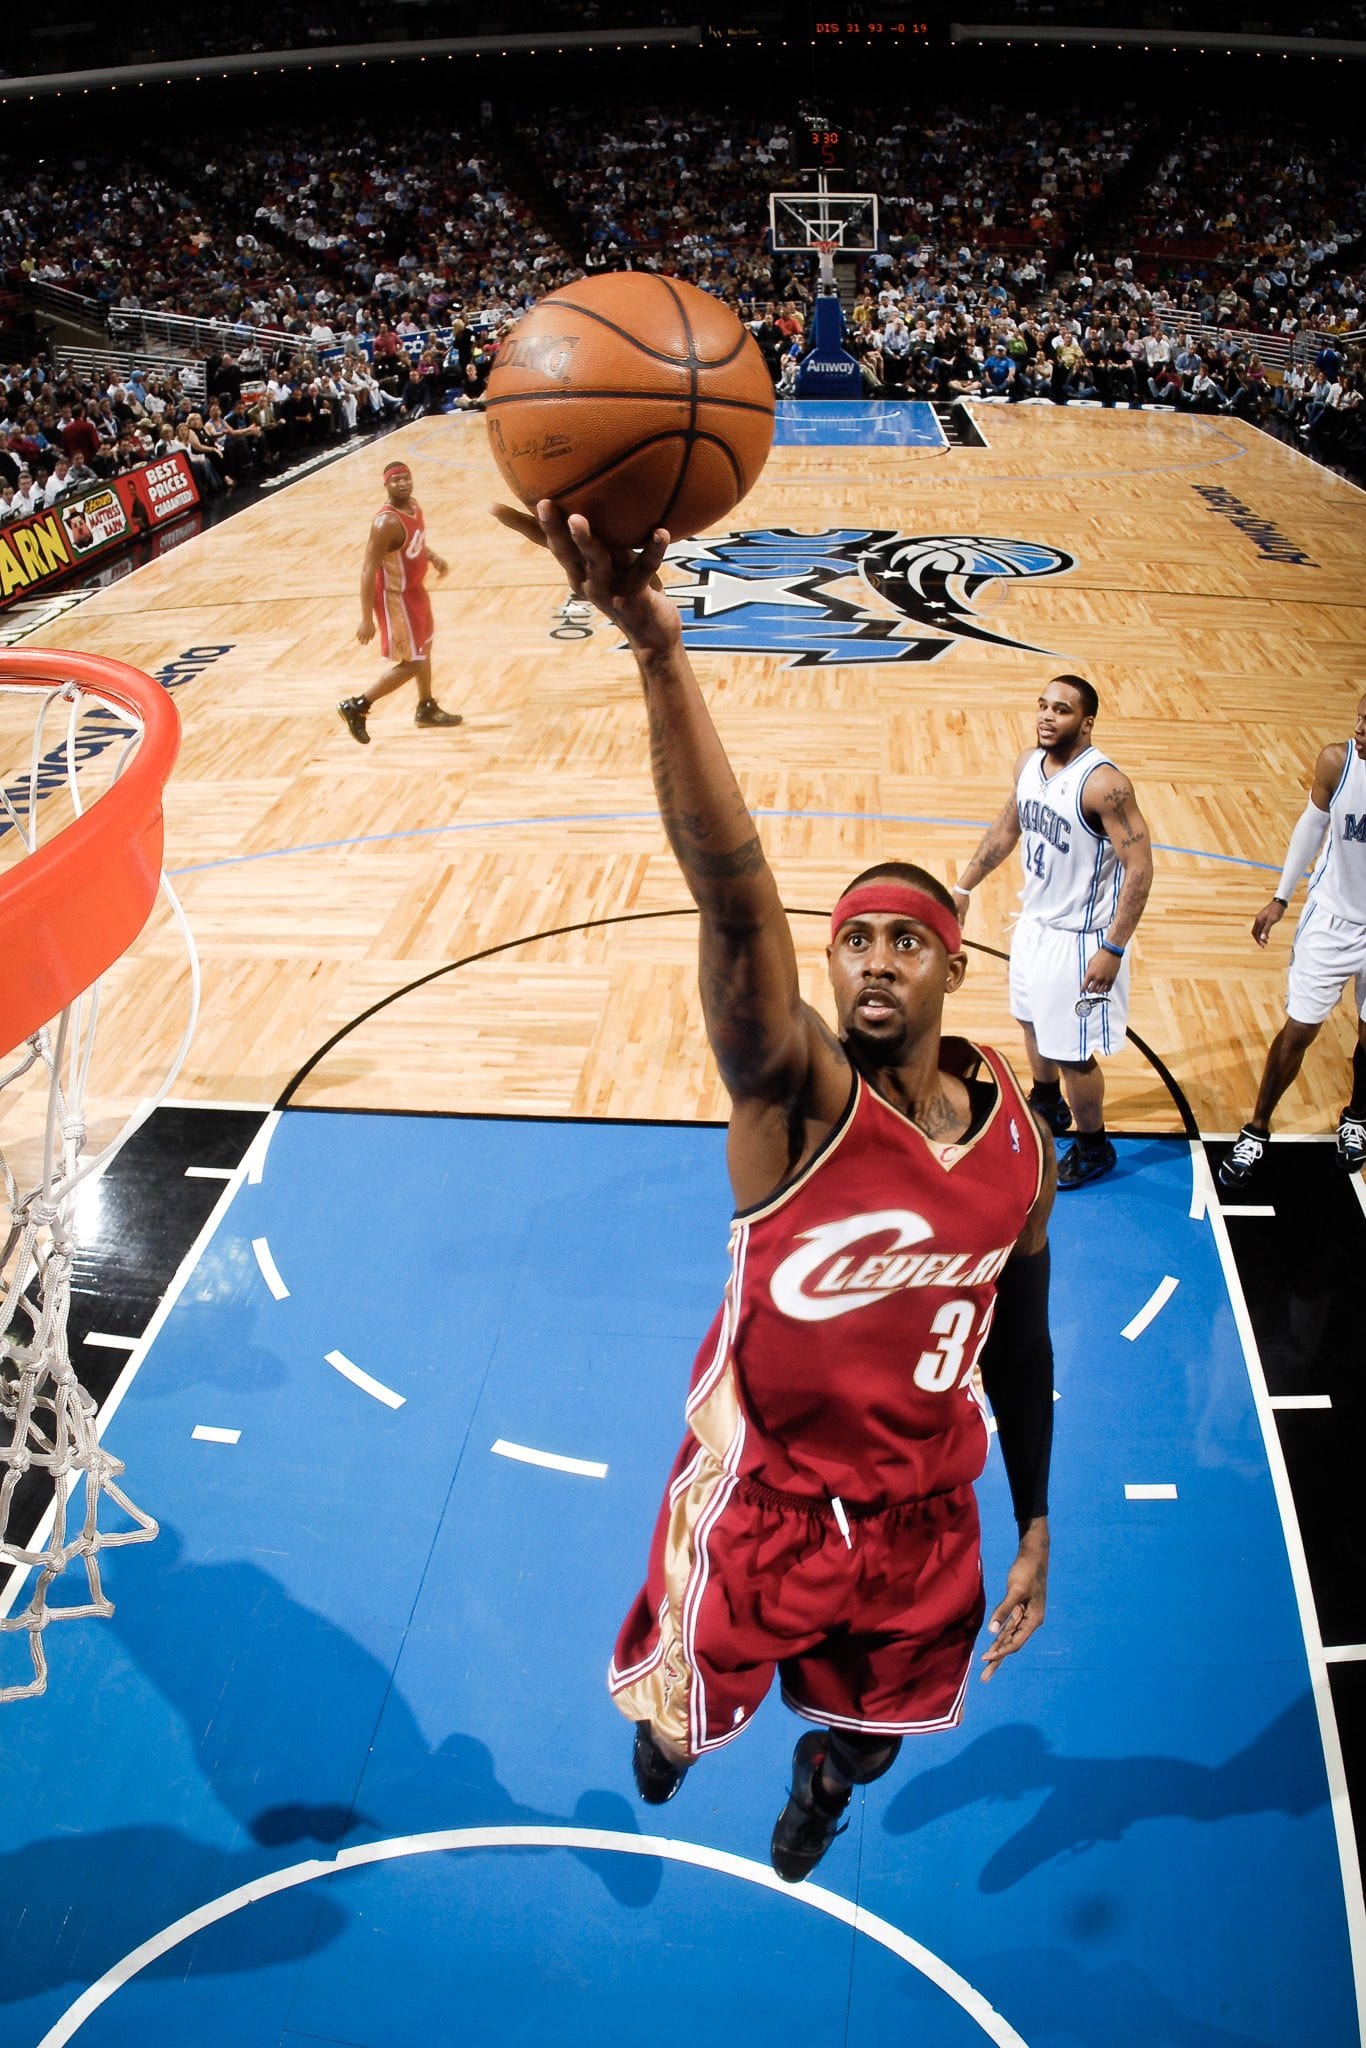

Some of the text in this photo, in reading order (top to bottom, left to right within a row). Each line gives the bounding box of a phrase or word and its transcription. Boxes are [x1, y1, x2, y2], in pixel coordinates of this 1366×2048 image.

[846, 23, 860, 33] 31
[867, 23, 883, 33] 93
[912, 23, 928, 33] 19
[806, 359, 855, 375] Amway
[145, 459, 178, 485] BEST
[147, 472, 188, 503] PRICES
[0, 515, 70, 598] ARN
[1018, 799, 1072, 855] MAGIC
[1026, 836, 1045, 880] 14
[769, 1208, 1018, 1321] CLEVELAN
